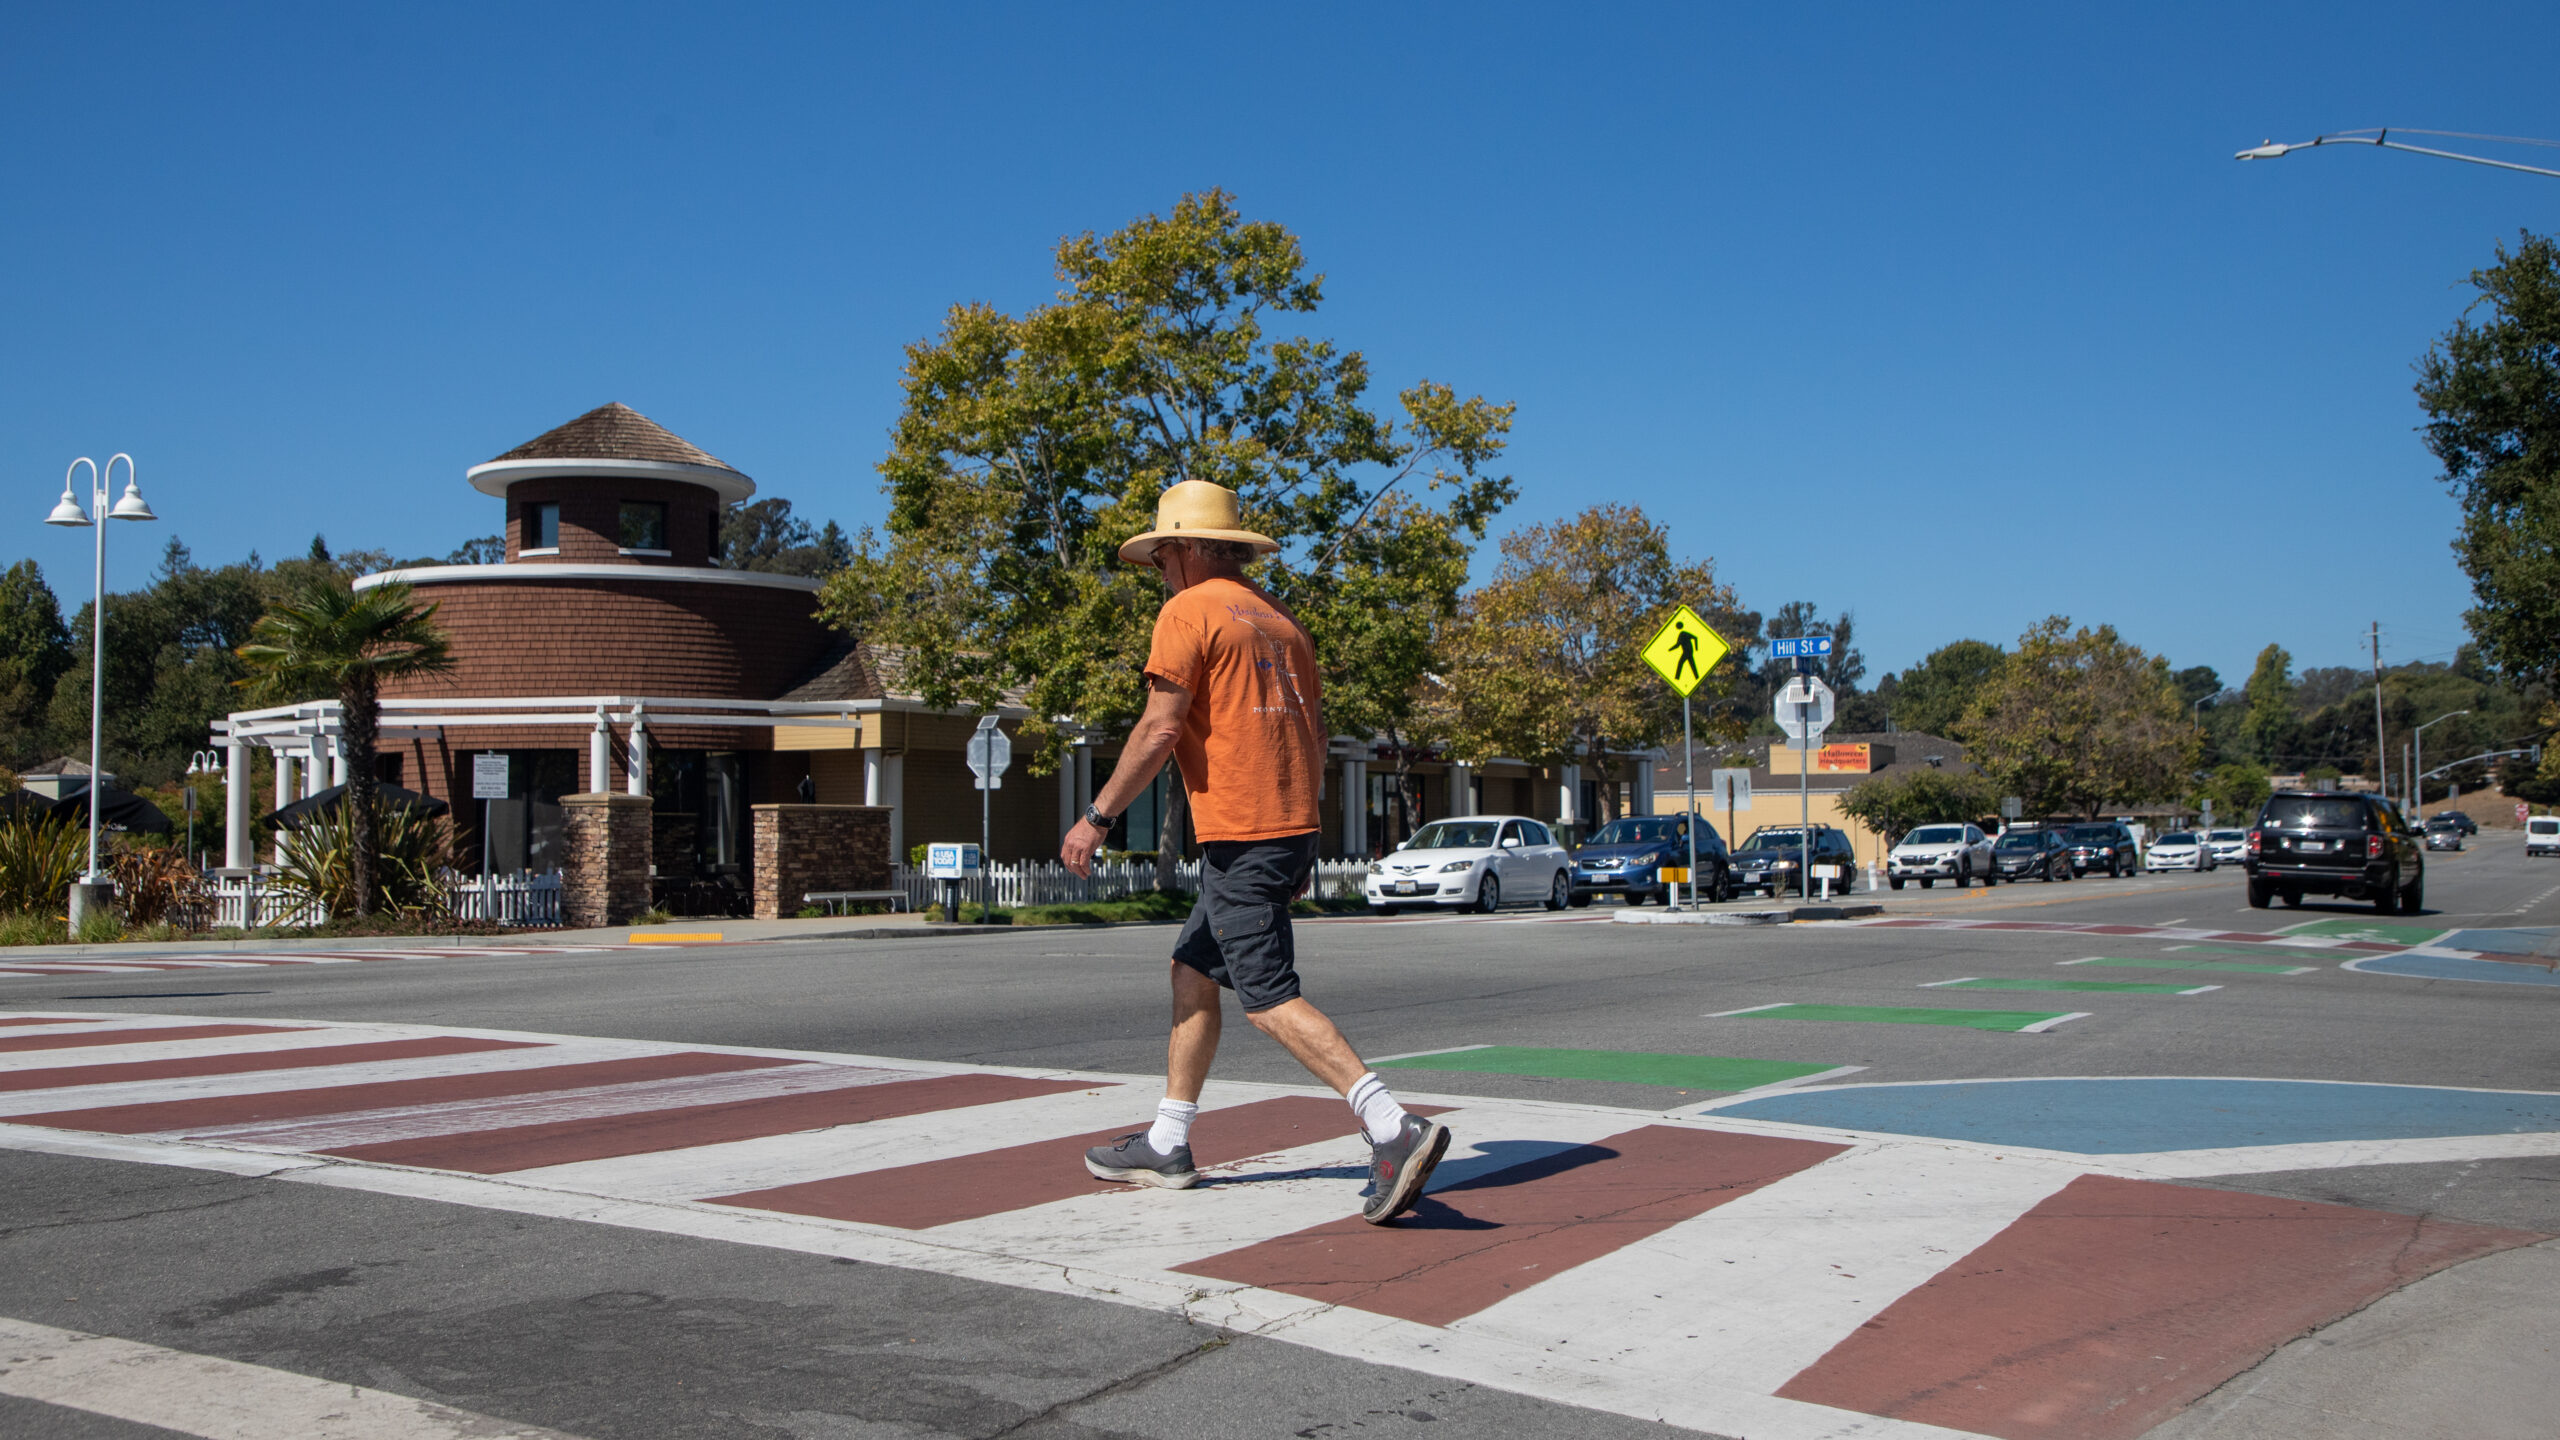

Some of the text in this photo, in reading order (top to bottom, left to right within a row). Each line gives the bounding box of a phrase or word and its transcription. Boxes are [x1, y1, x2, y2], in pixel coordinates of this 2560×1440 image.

[1777, 639, 1814, 655] Hill St
[940, 850, 954, 858] USA
[934, 857, 955, 865] TODAY
